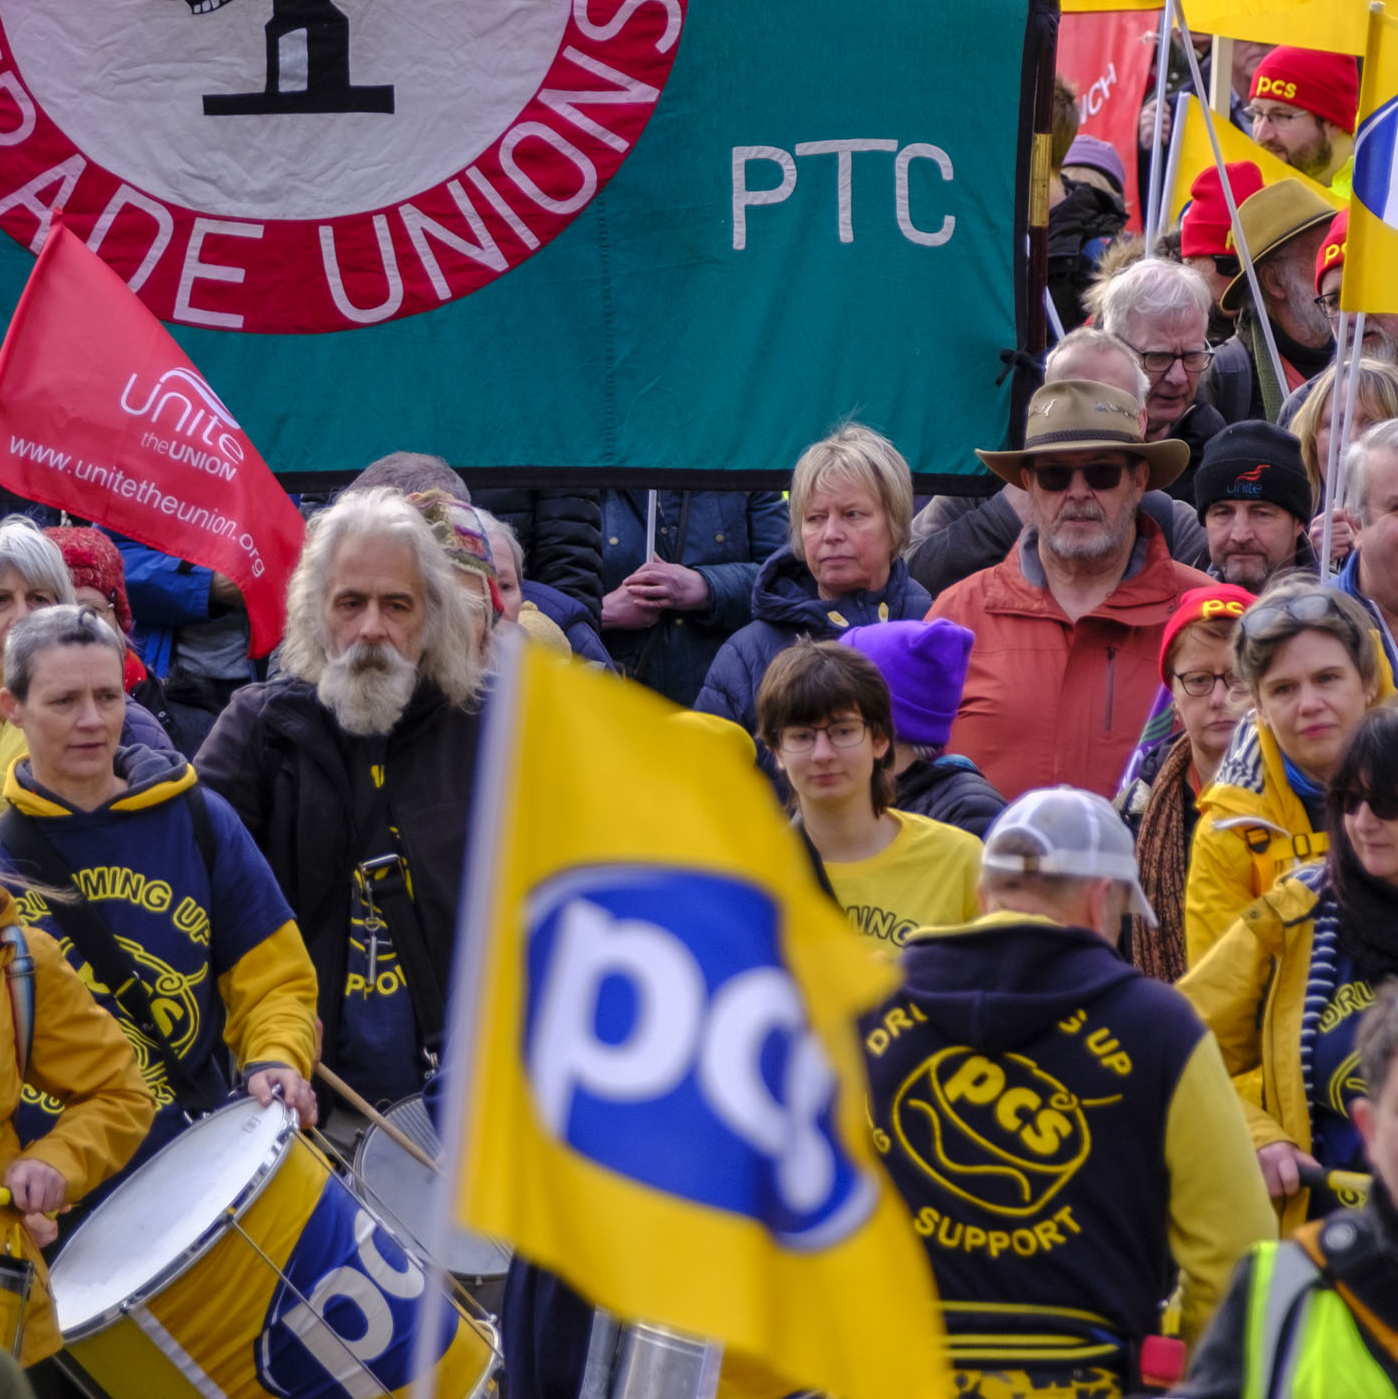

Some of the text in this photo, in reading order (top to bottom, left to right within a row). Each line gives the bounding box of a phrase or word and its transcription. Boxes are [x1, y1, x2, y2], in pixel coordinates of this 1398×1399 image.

[1256, 76, 1297, 100] pcs
[731, 138, 956, 251] PTC
[9, 435, 266, 579] www.unitetheunion.org
[1201, 599, 1245, 621] pc
[1086, 1027, 1132, 1077] UP
[913, 1204, 1083, 1258] SUPPORT
